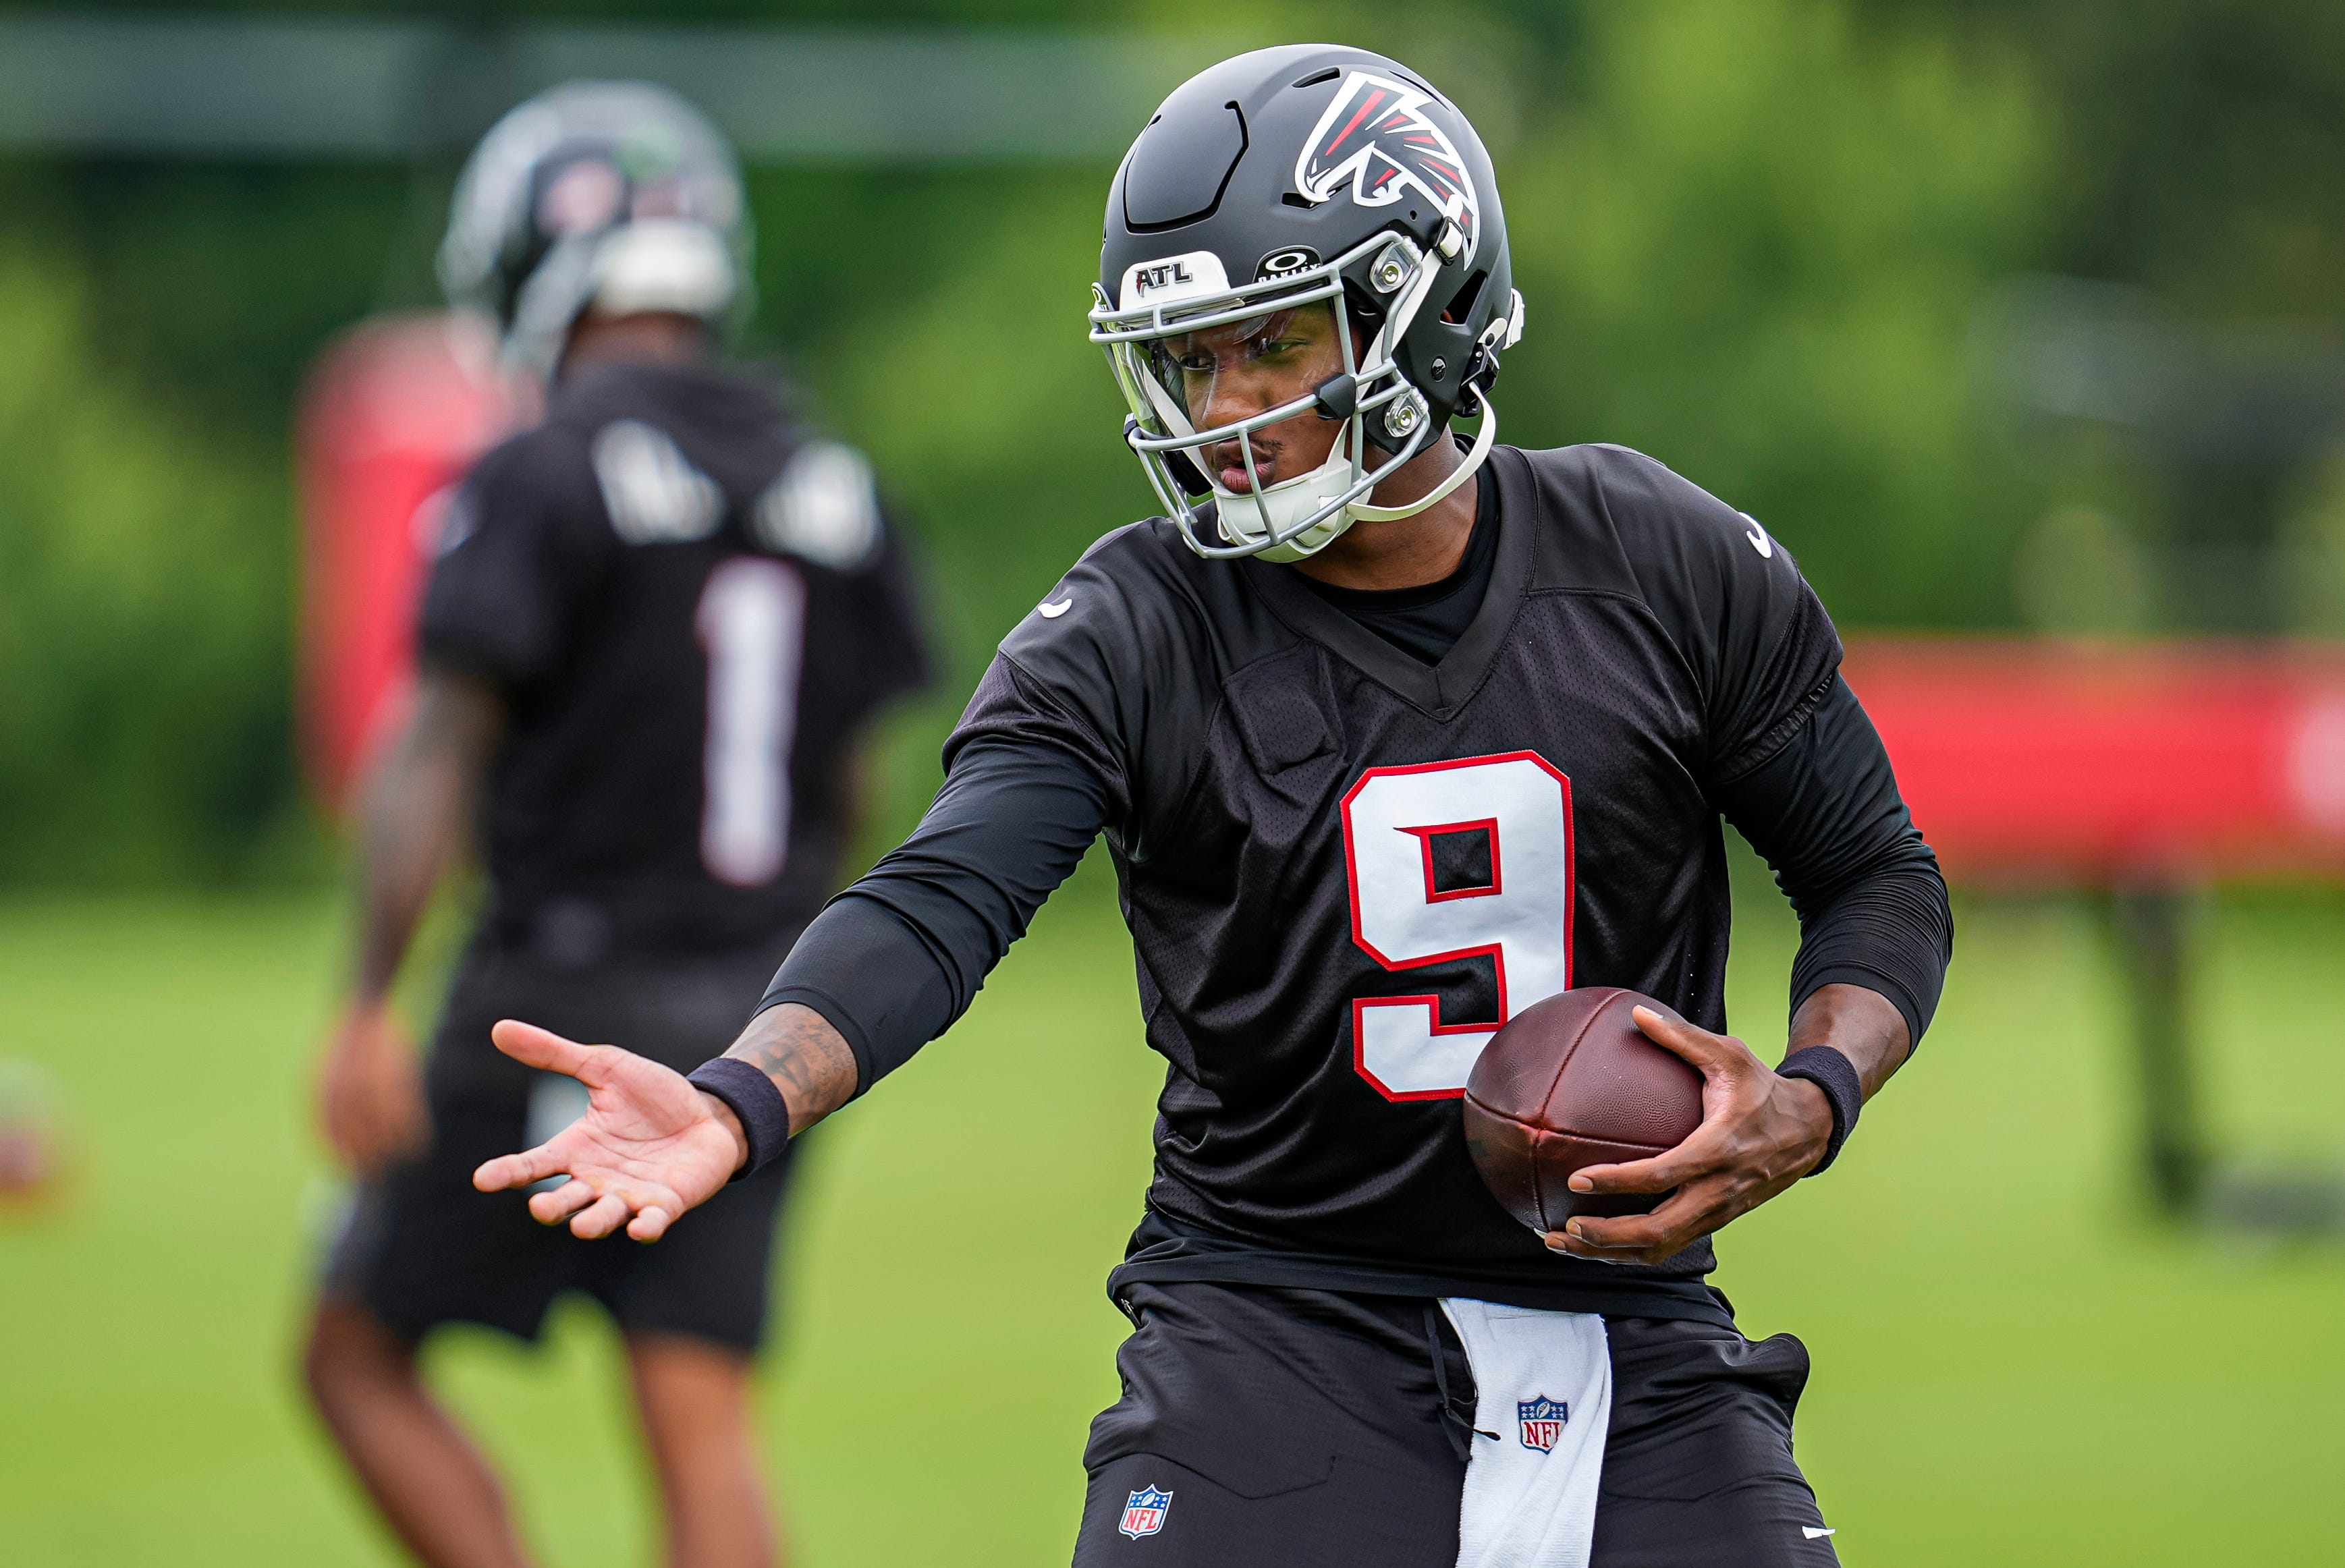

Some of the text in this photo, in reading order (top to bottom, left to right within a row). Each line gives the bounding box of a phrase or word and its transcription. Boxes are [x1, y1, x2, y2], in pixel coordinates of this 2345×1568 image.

[1135, 261, 1192, 298] ATL
[696, 556, 806, 887] 1
[1340, 750, 1574, 1102] 9
[1124, 1509, 1157, 1532] NFL
